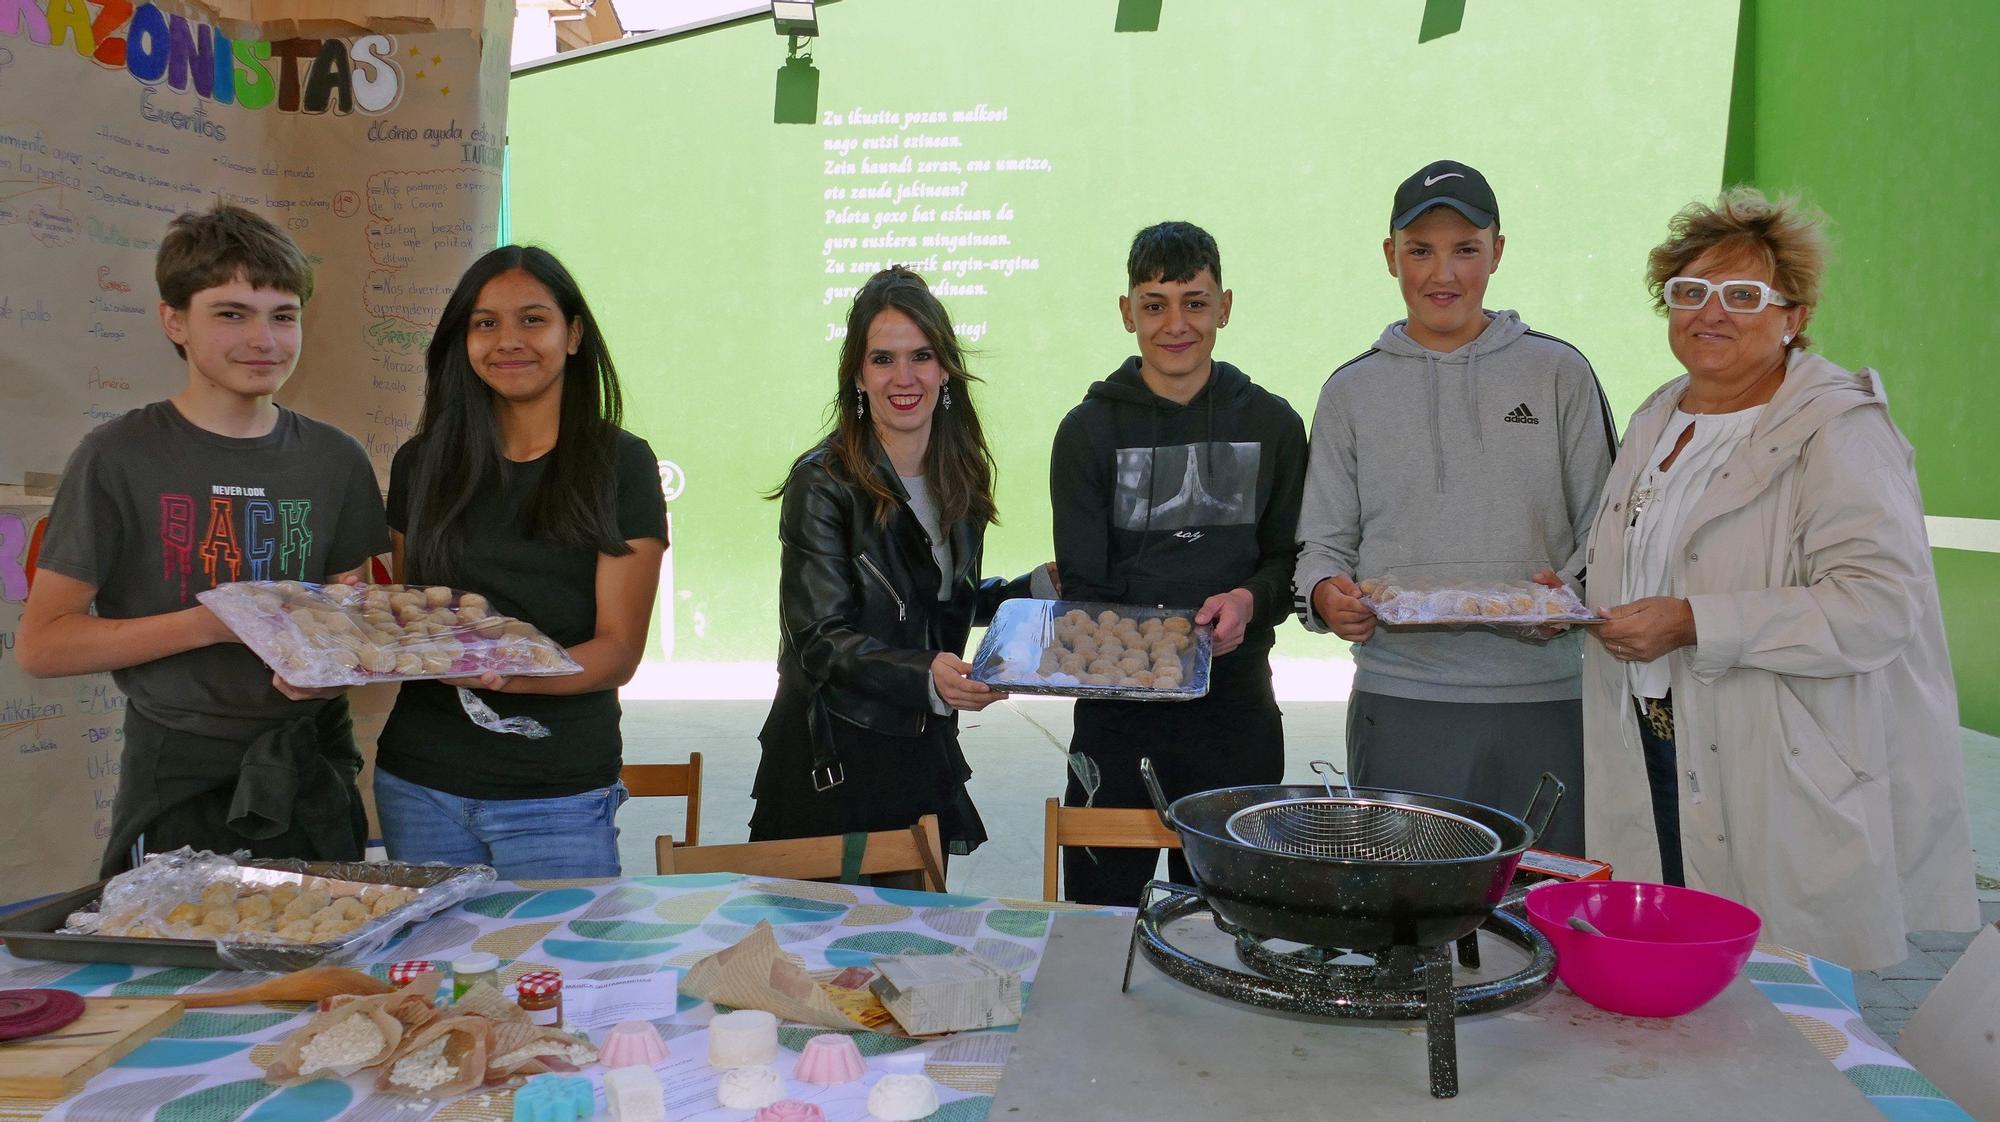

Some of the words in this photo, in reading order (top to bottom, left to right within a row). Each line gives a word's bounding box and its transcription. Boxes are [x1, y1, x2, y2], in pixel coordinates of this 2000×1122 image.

[140, 87, 226, 143] Eventos
[823, 111, 843, 126] Zu
[848, 107, 900, 125] ikusita
[899, 110, 947, 131] pozan
[952, 104, 1008, 123] malkoei
[423, 120, 463, 147] ayuda
[824, 138, 858, 157] nago
[862, 134, 899, 149] eutsi
[903, 134, 962, 149] ezinean.
[284, 165, 315, 179] mundo
[824, 160, 856, 175] Zein
[861, 155, 912, 175] haundi
[918, 161, 962, 174] zeran,
[967, 160, 992, 172] ene
[996, 158, 1052, 173] umetxo,
[824, 187, 846, 200] ote
[850, 180, 892, 199] zaude
[893, 180, 968, 205] jakinean?
[826, 207, 870, 225] Pelota
[872, 211, 908, 230] goxo
[912, 205, 936, 223] bat
[941, 204, 991, 222] eskuan
[996, 203, 1015, 221] da
[824, 238, 857, 256] gure
[862, 230, 917, 249] euskera
[922, 232, 1011, 254] mingainean.
[825, 259, 845, 274] Zu
[850, 262, 881, 275] zera
[943, 256, 1040, 278] argin-argina
[928, 279, 987, 297] rdinean.
[20, 299, 51, 328] pollo
[952, 322, 987, 342] ategi
[1504, 416, 1539, 424] adidas
[212, 485, 242, 496] NEVER
[243, 487, 265, 497] LOOK
[658, 466, 674, 495] 2
[160, 493, 313, 577] BACK
